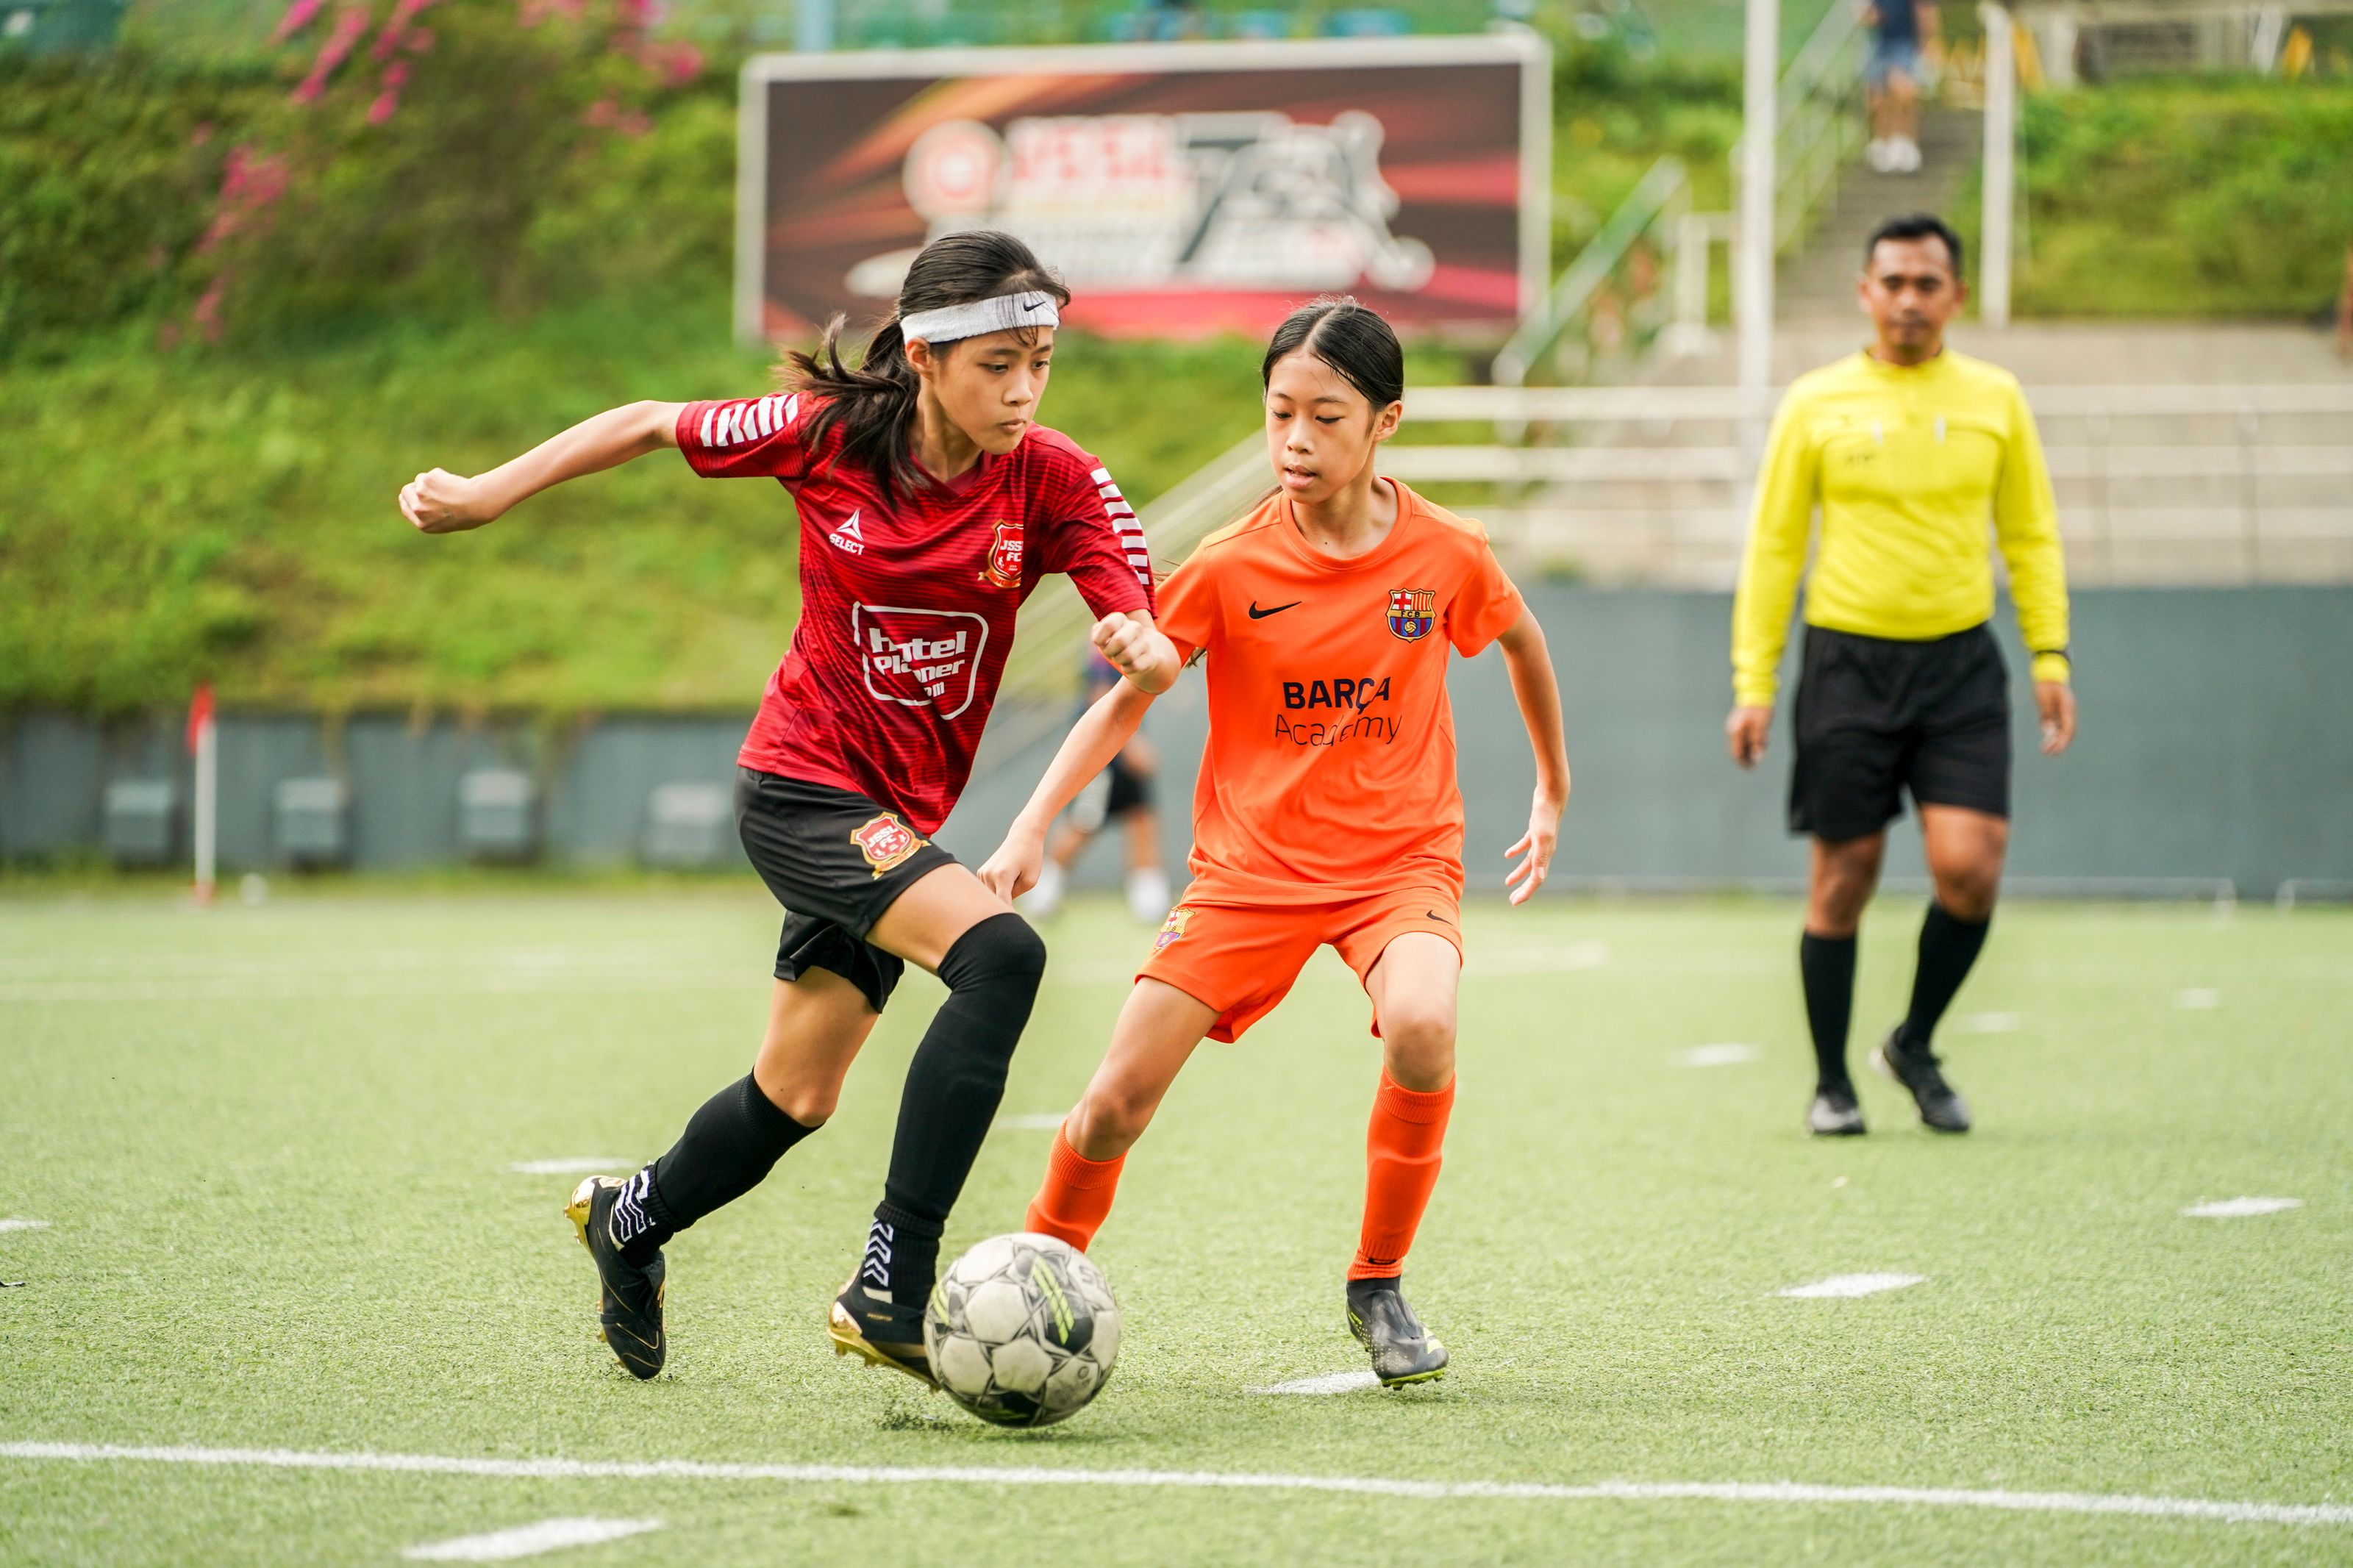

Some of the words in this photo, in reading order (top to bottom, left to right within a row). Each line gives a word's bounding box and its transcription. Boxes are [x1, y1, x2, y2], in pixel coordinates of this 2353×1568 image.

[829, 533, 865, 555] SELECT
[1000, 540, 1024, 551] JSS
[1006, 552, 1021, 562] FC
[1282, 676, 1391, 715] BARÇA
[1275, 714, 1402, 747] Academy
[868, 825, 899, 847] JSSL
[879, 834, 896, 848] FC
